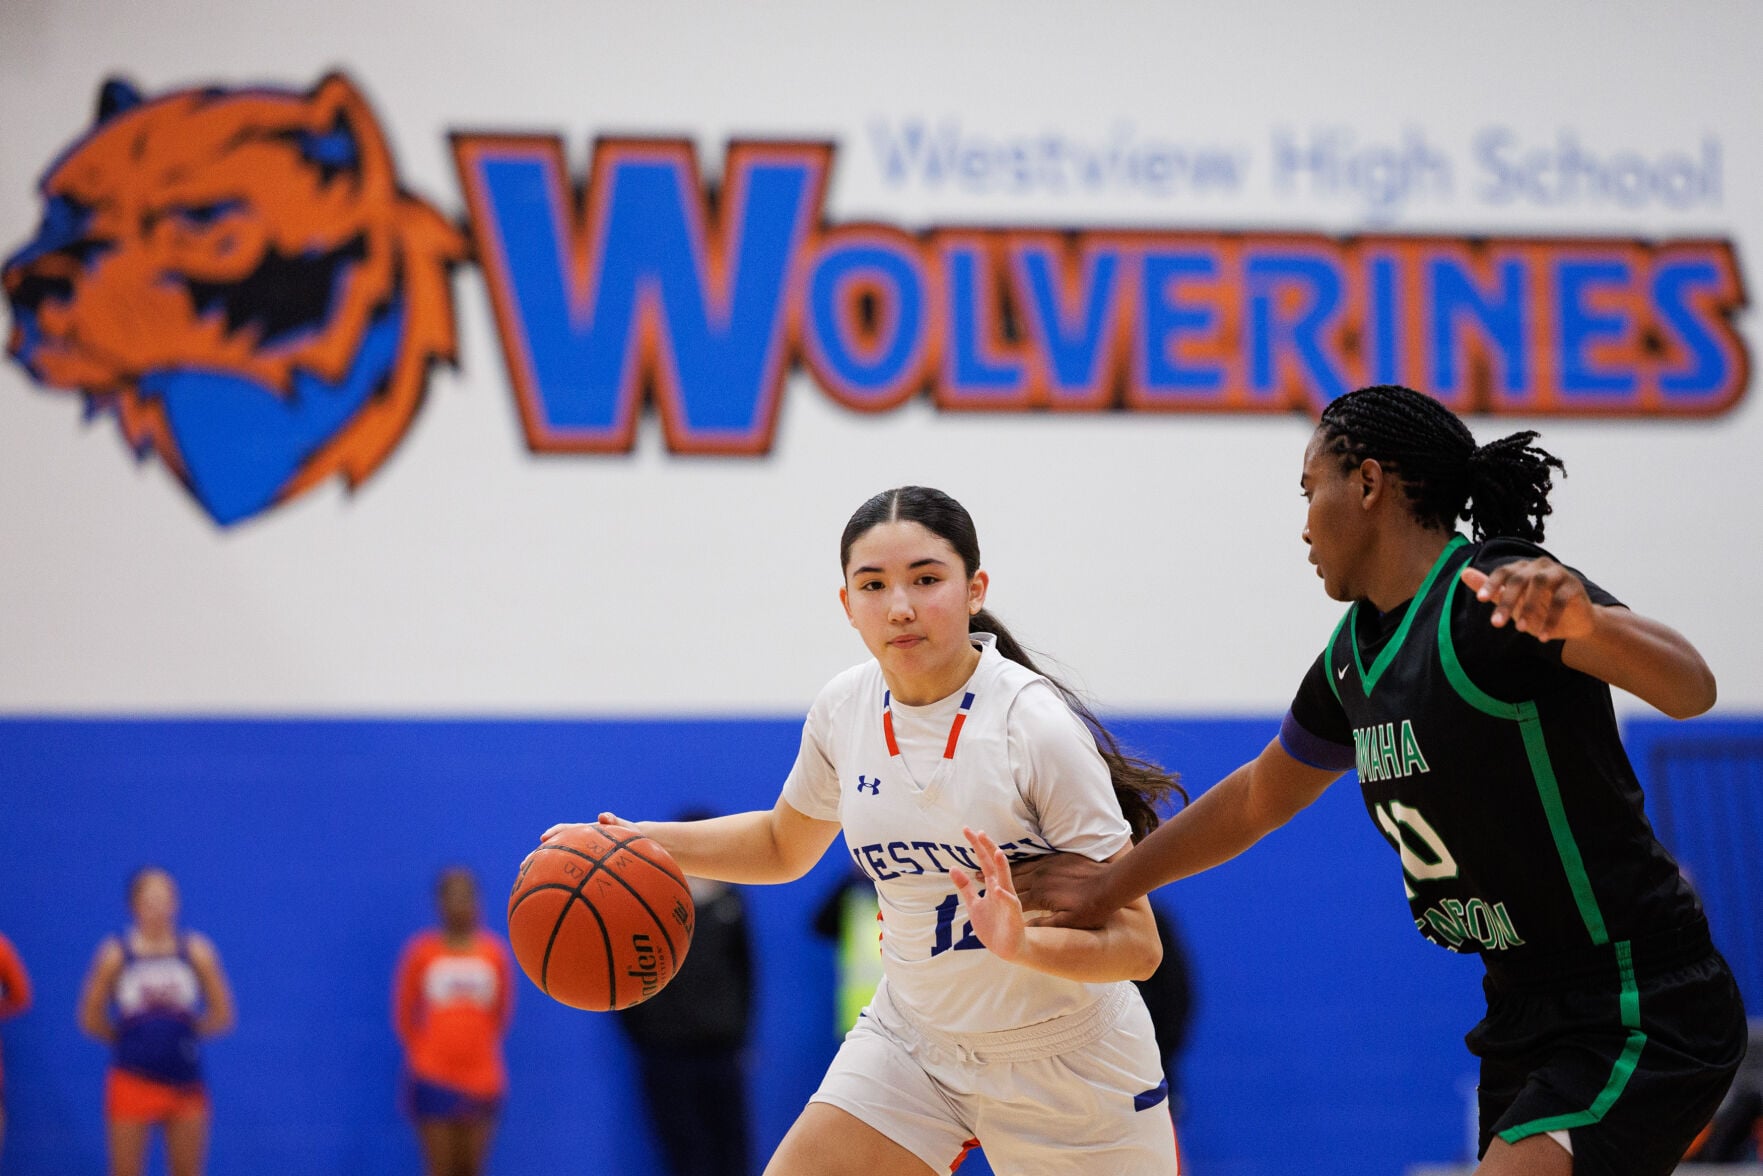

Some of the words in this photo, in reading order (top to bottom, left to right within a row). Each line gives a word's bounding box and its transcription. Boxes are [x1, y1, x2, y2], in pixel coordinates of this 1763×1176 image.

[868, 117, 1248, 198] Westview
[1272, 122, 1453, 227] High
[1473, 123, 1723, 208] School
[450, 133, 1755, 456] WOLVERINES
[1415, 898, 1526, 952] NSON
